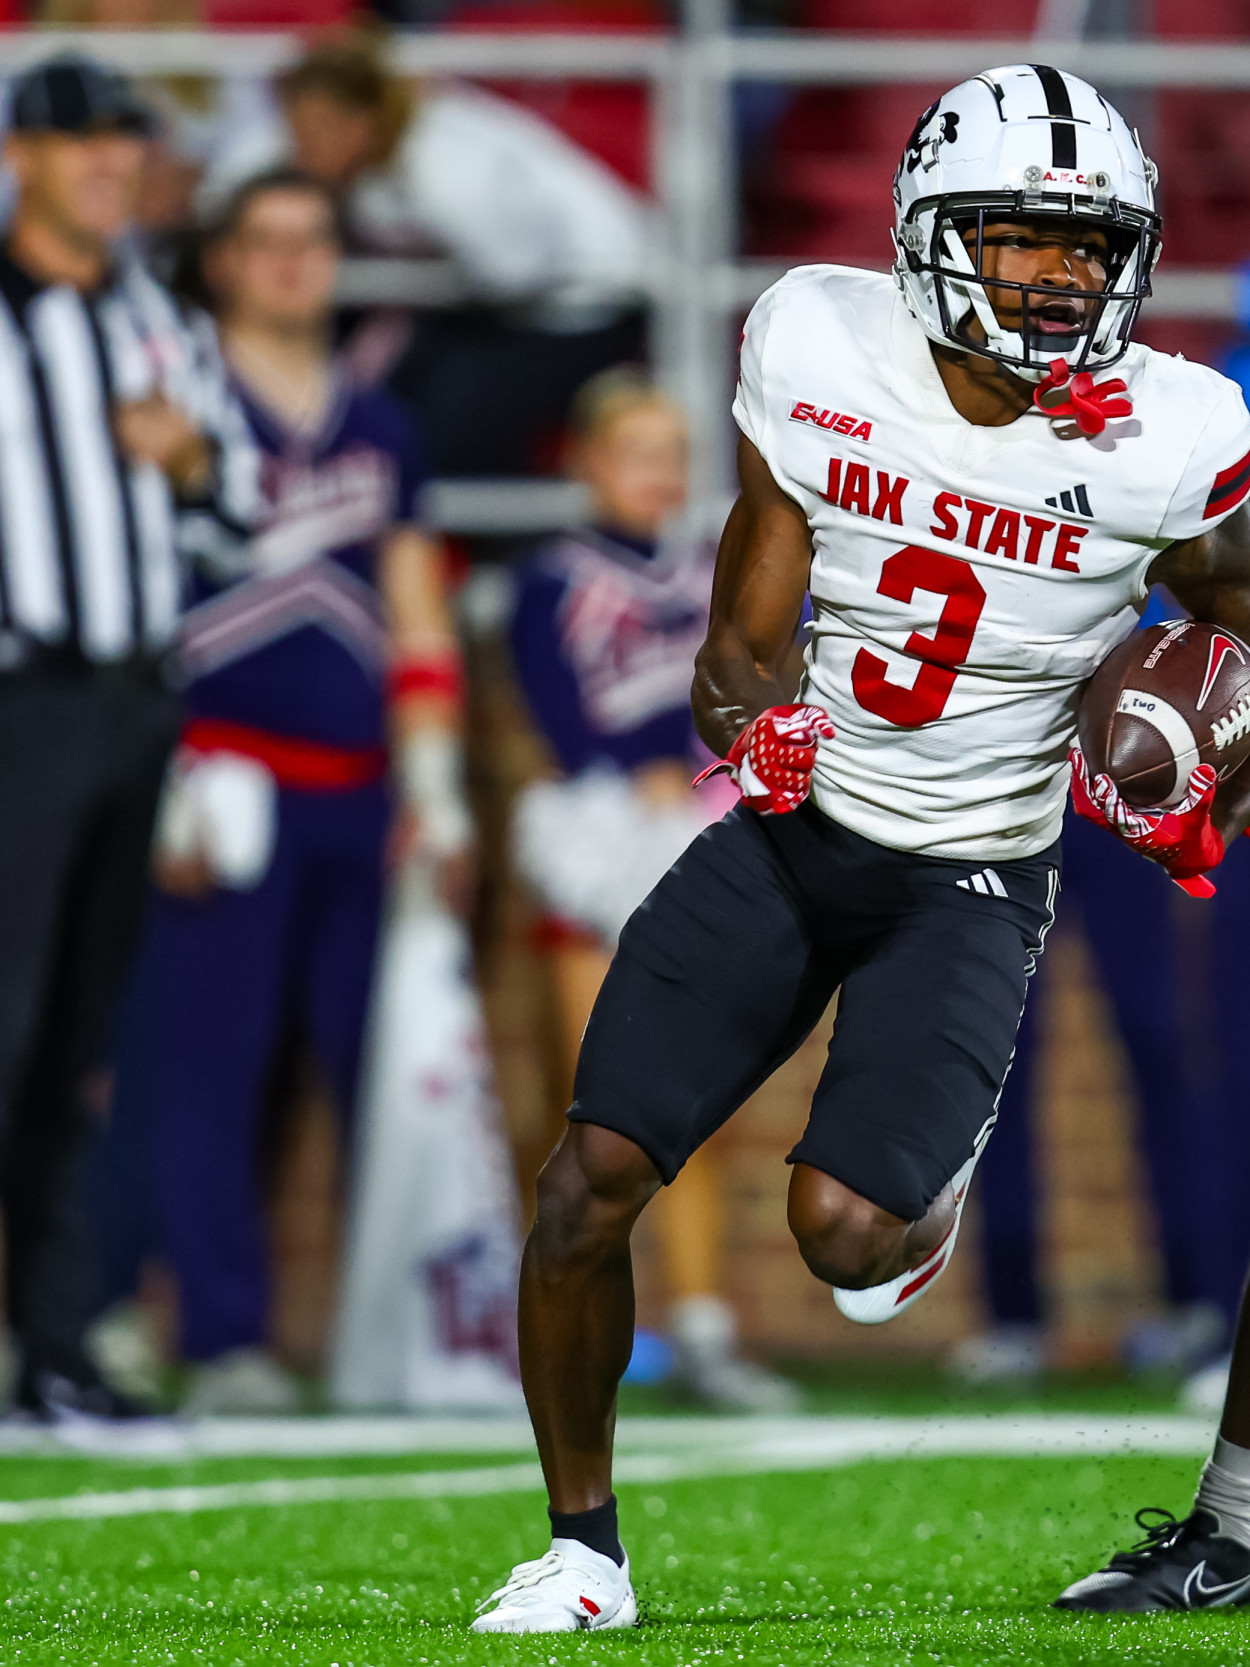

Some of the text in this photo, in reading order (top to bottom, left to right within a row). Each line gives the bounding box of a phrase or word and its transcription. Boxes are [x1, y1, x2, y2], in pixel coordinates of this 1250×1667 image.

[816, 457, 1090, 574] JAX STATE
[851, 544, 988, 728] 3
